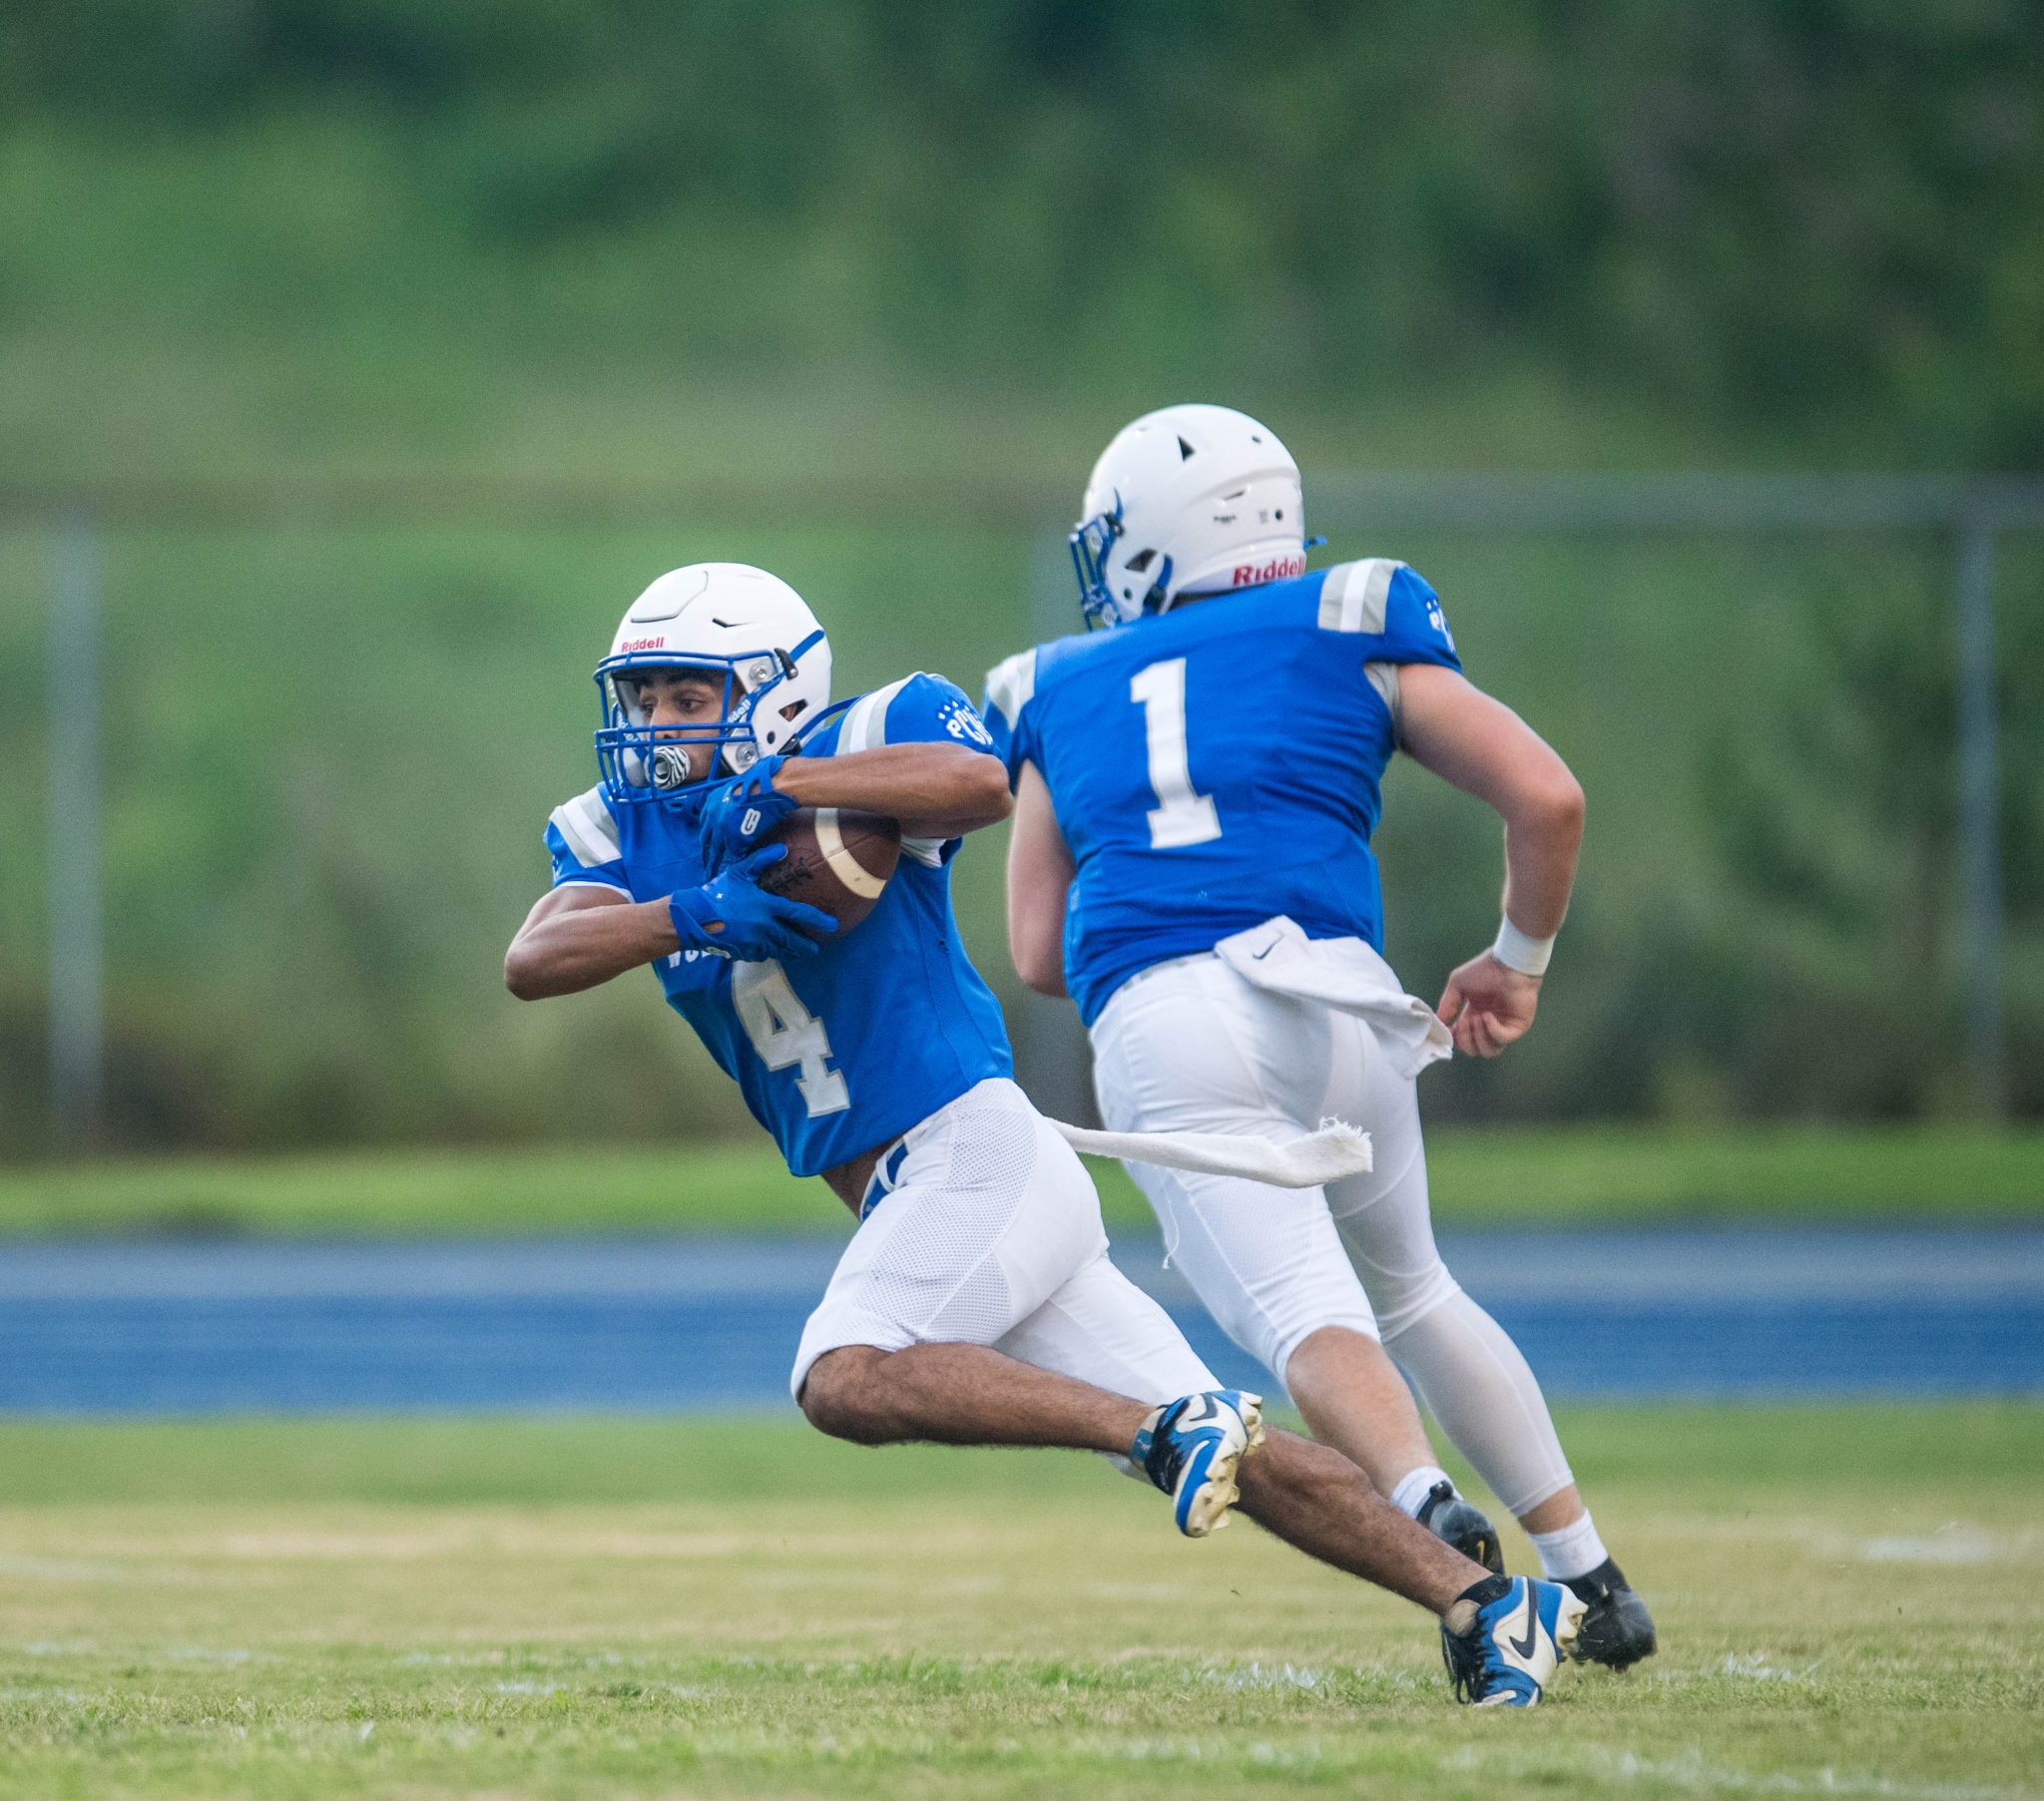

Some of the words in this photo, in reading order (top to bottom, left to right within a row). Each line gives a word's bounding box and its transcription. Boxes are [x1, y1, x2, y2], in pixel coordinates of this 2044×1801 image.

[621, 637, 665, 653] Riddell
[1131, 657, 1223, 848] 1
[732, 958, 850, 1118] 4
